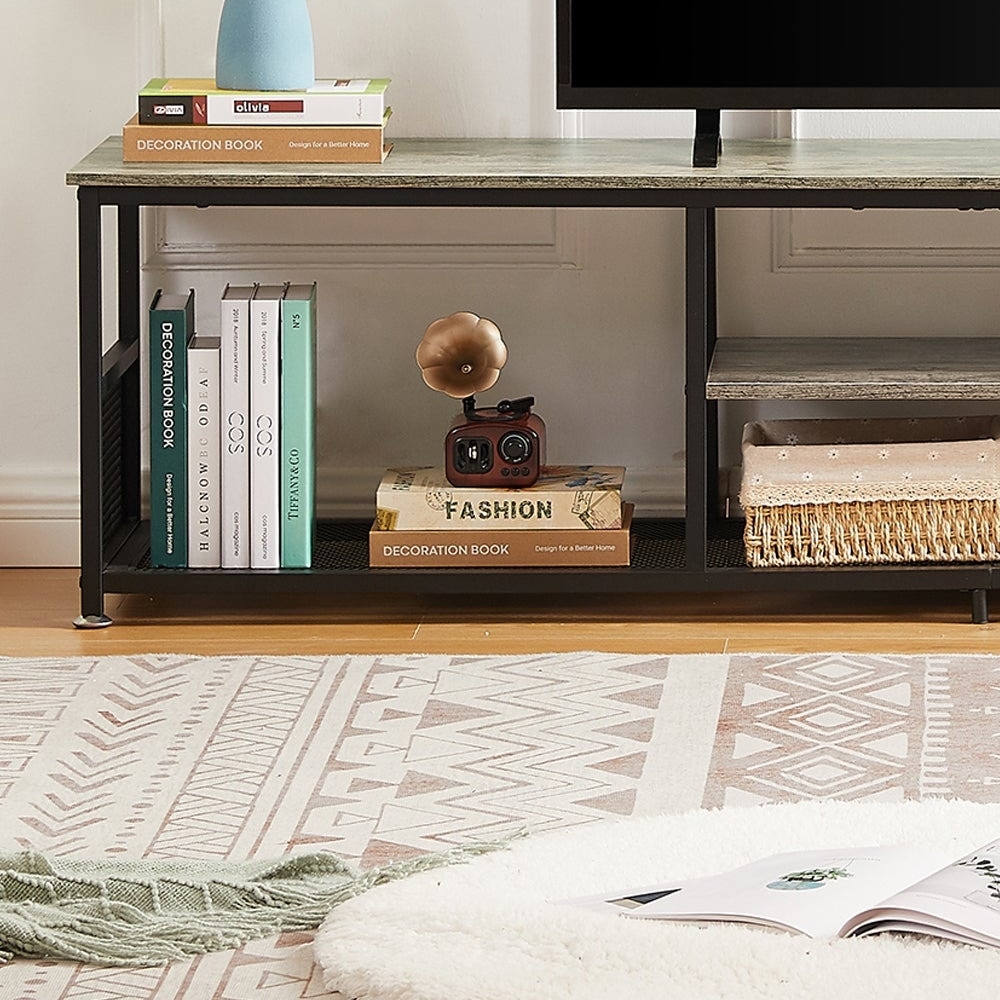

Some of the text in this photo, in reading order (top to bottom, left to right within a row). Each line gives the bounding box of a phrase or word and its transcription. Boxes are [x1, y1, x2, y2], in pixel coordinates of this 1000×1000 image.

[236, 101, 270, 112] olivia
[137, 140, 263, 150] DECORATION BOOK
[288, 141, 312, 149] Design
[162, 322, 175, 448] DECORATION BOOK
[228, 411, 244, 454] COS
[256, 414, 272, 457] COS
[165, 473, 173, 496] Design
[287, 448, 300, 521] TIFFANY&CO
[445, 500, 552, 519] FASHION
[383, 544, 509, 556] DECORATION BOOK
[535, 545, 557, 553] Design
